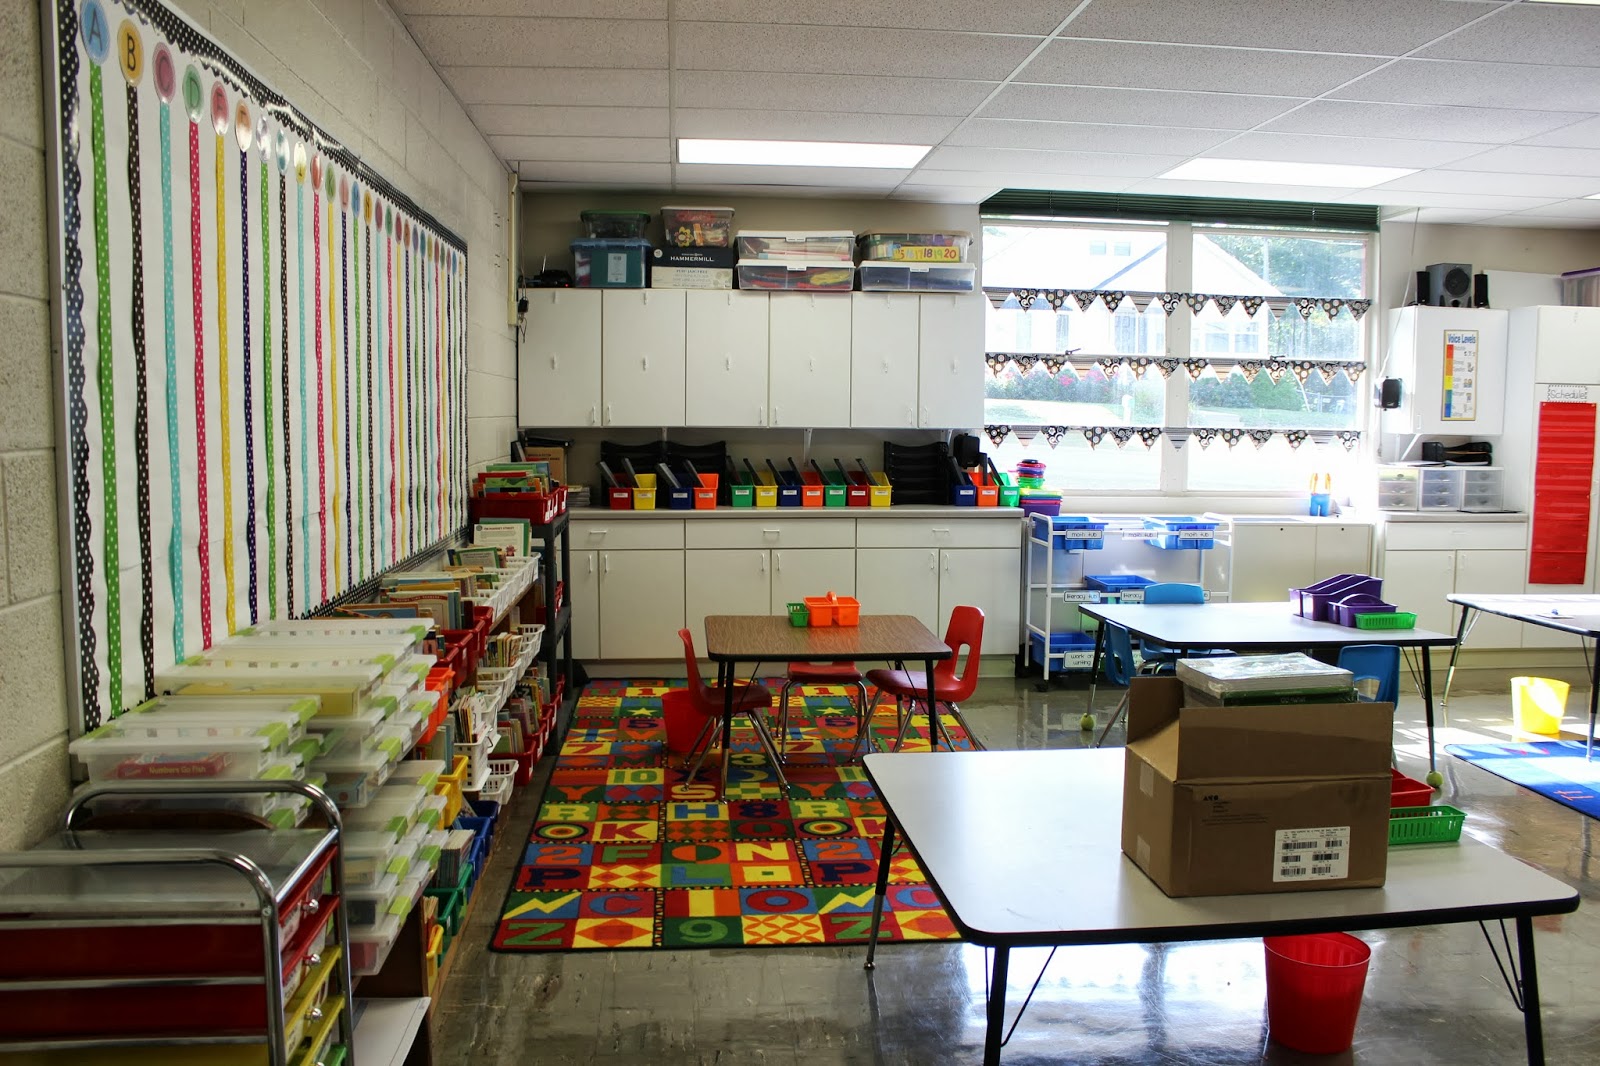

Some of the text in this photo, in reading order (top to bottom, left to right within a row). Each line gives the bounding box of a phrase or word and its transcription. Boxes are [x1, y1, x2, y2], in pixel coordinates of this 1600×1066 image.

[88, 8, 103, 52] A
[127, 32, 136, 71] B
[158, 55, 170, 92] C
[189, 77, 200, 108] D
[923, 248, 933, 258] 18
[934, 249, 943, 259] 19
[944, 248, 957, 259] 20
[1448, 334, 1476, 344] Voice Levels
[1550, 389, 1585, 399] Schedule
[637, 687, 657, 696] 1
[814, 687, 834, 695] 1
[627, 719, 659, 729] 5
[824, 718, 855, 727] 5
[566, 743, 603, 754] 7
[730, 753, 767, 766] 3
[149, 765, 179, 775] Numbers
[181, 765, 190, 774] Go
[192, 764, 206, 774] Fish
[613, 770, 657, 784] 10
[557, 786, 599, 800] Y
[671, 784, 716, 800] S
[795, 783, 832, 797] Y
[541, 804, 590, 821] R
[674, 803, 719, 819] H
[739, 802, 780, 818] 8
[794, 801, 845, 818] R
[599, 822, 650, 839] K
[535, 845, 582, 865] 2
[601, 845, 653, 863] F
[735, 842, 789, 861] N
[815, 841, 860, 860] 2
[524, 867, 581, 887] P
[671, 866, 723, 885] L
[817, 862, 872, 882] P
[589, 893, 642, 915] C
[746, 889, 809, 913] O
[503, 922, 565, 945] Z
[679, 919, 728, 943] 9
[830, 916, 893, 939] Z
